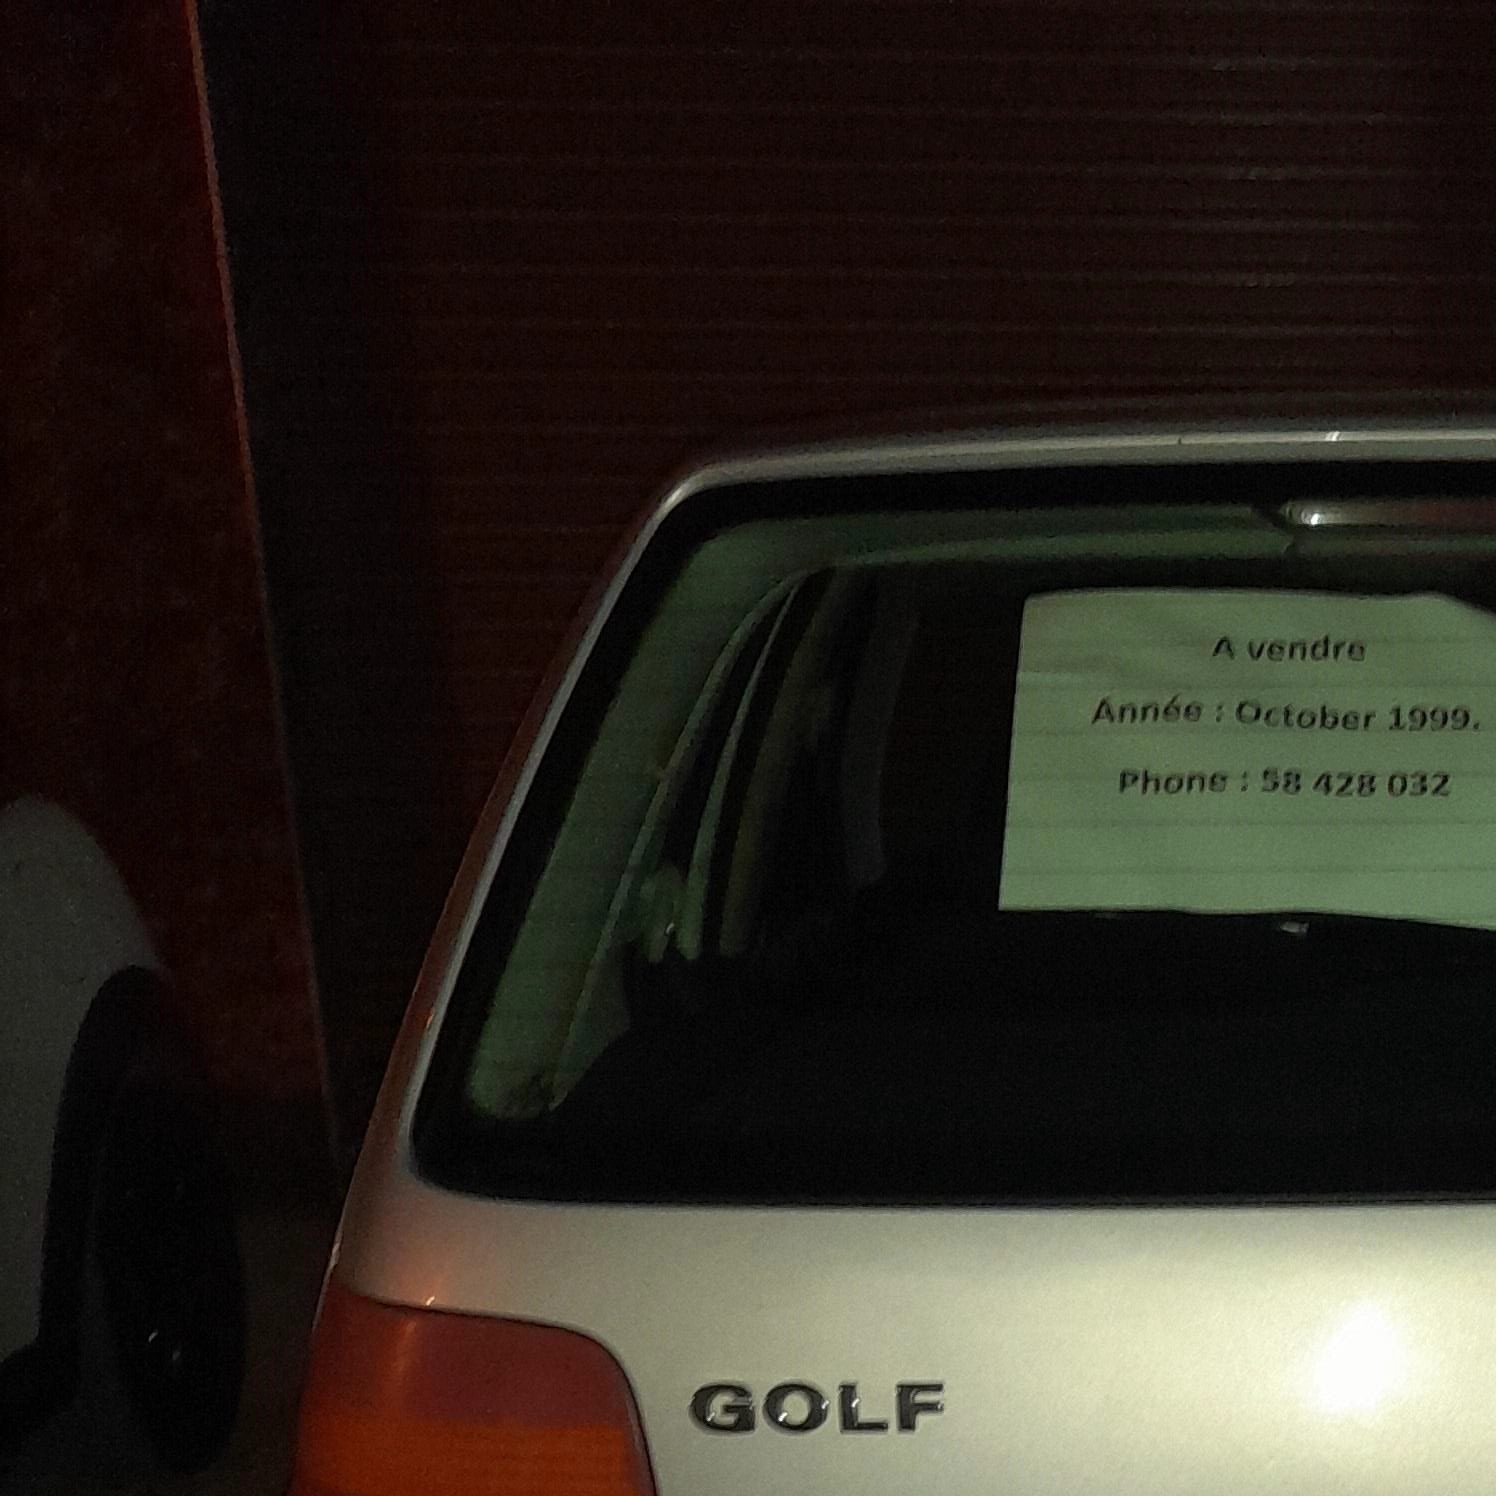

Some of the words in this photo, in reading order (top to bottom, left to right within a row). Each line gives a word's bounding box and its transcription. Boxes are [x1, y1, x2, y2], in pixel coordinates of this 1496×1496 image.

[1212, 634, 1235, 660] A
[1247, 633, 1367, 662] vendre
[1090, 692, 1203, 725] Année
[1235, 698, 1377, 732] October
[1387, 705, 1481, 732] 1999.
[1118, 768, 1228, 796] Phone
[1260, 767, 1301, 796] 58
[1312, 770, 1377, 798] 428
[1386, 771, 1453, 799] 032
[690, 1382, 945, 1432] GOLF
